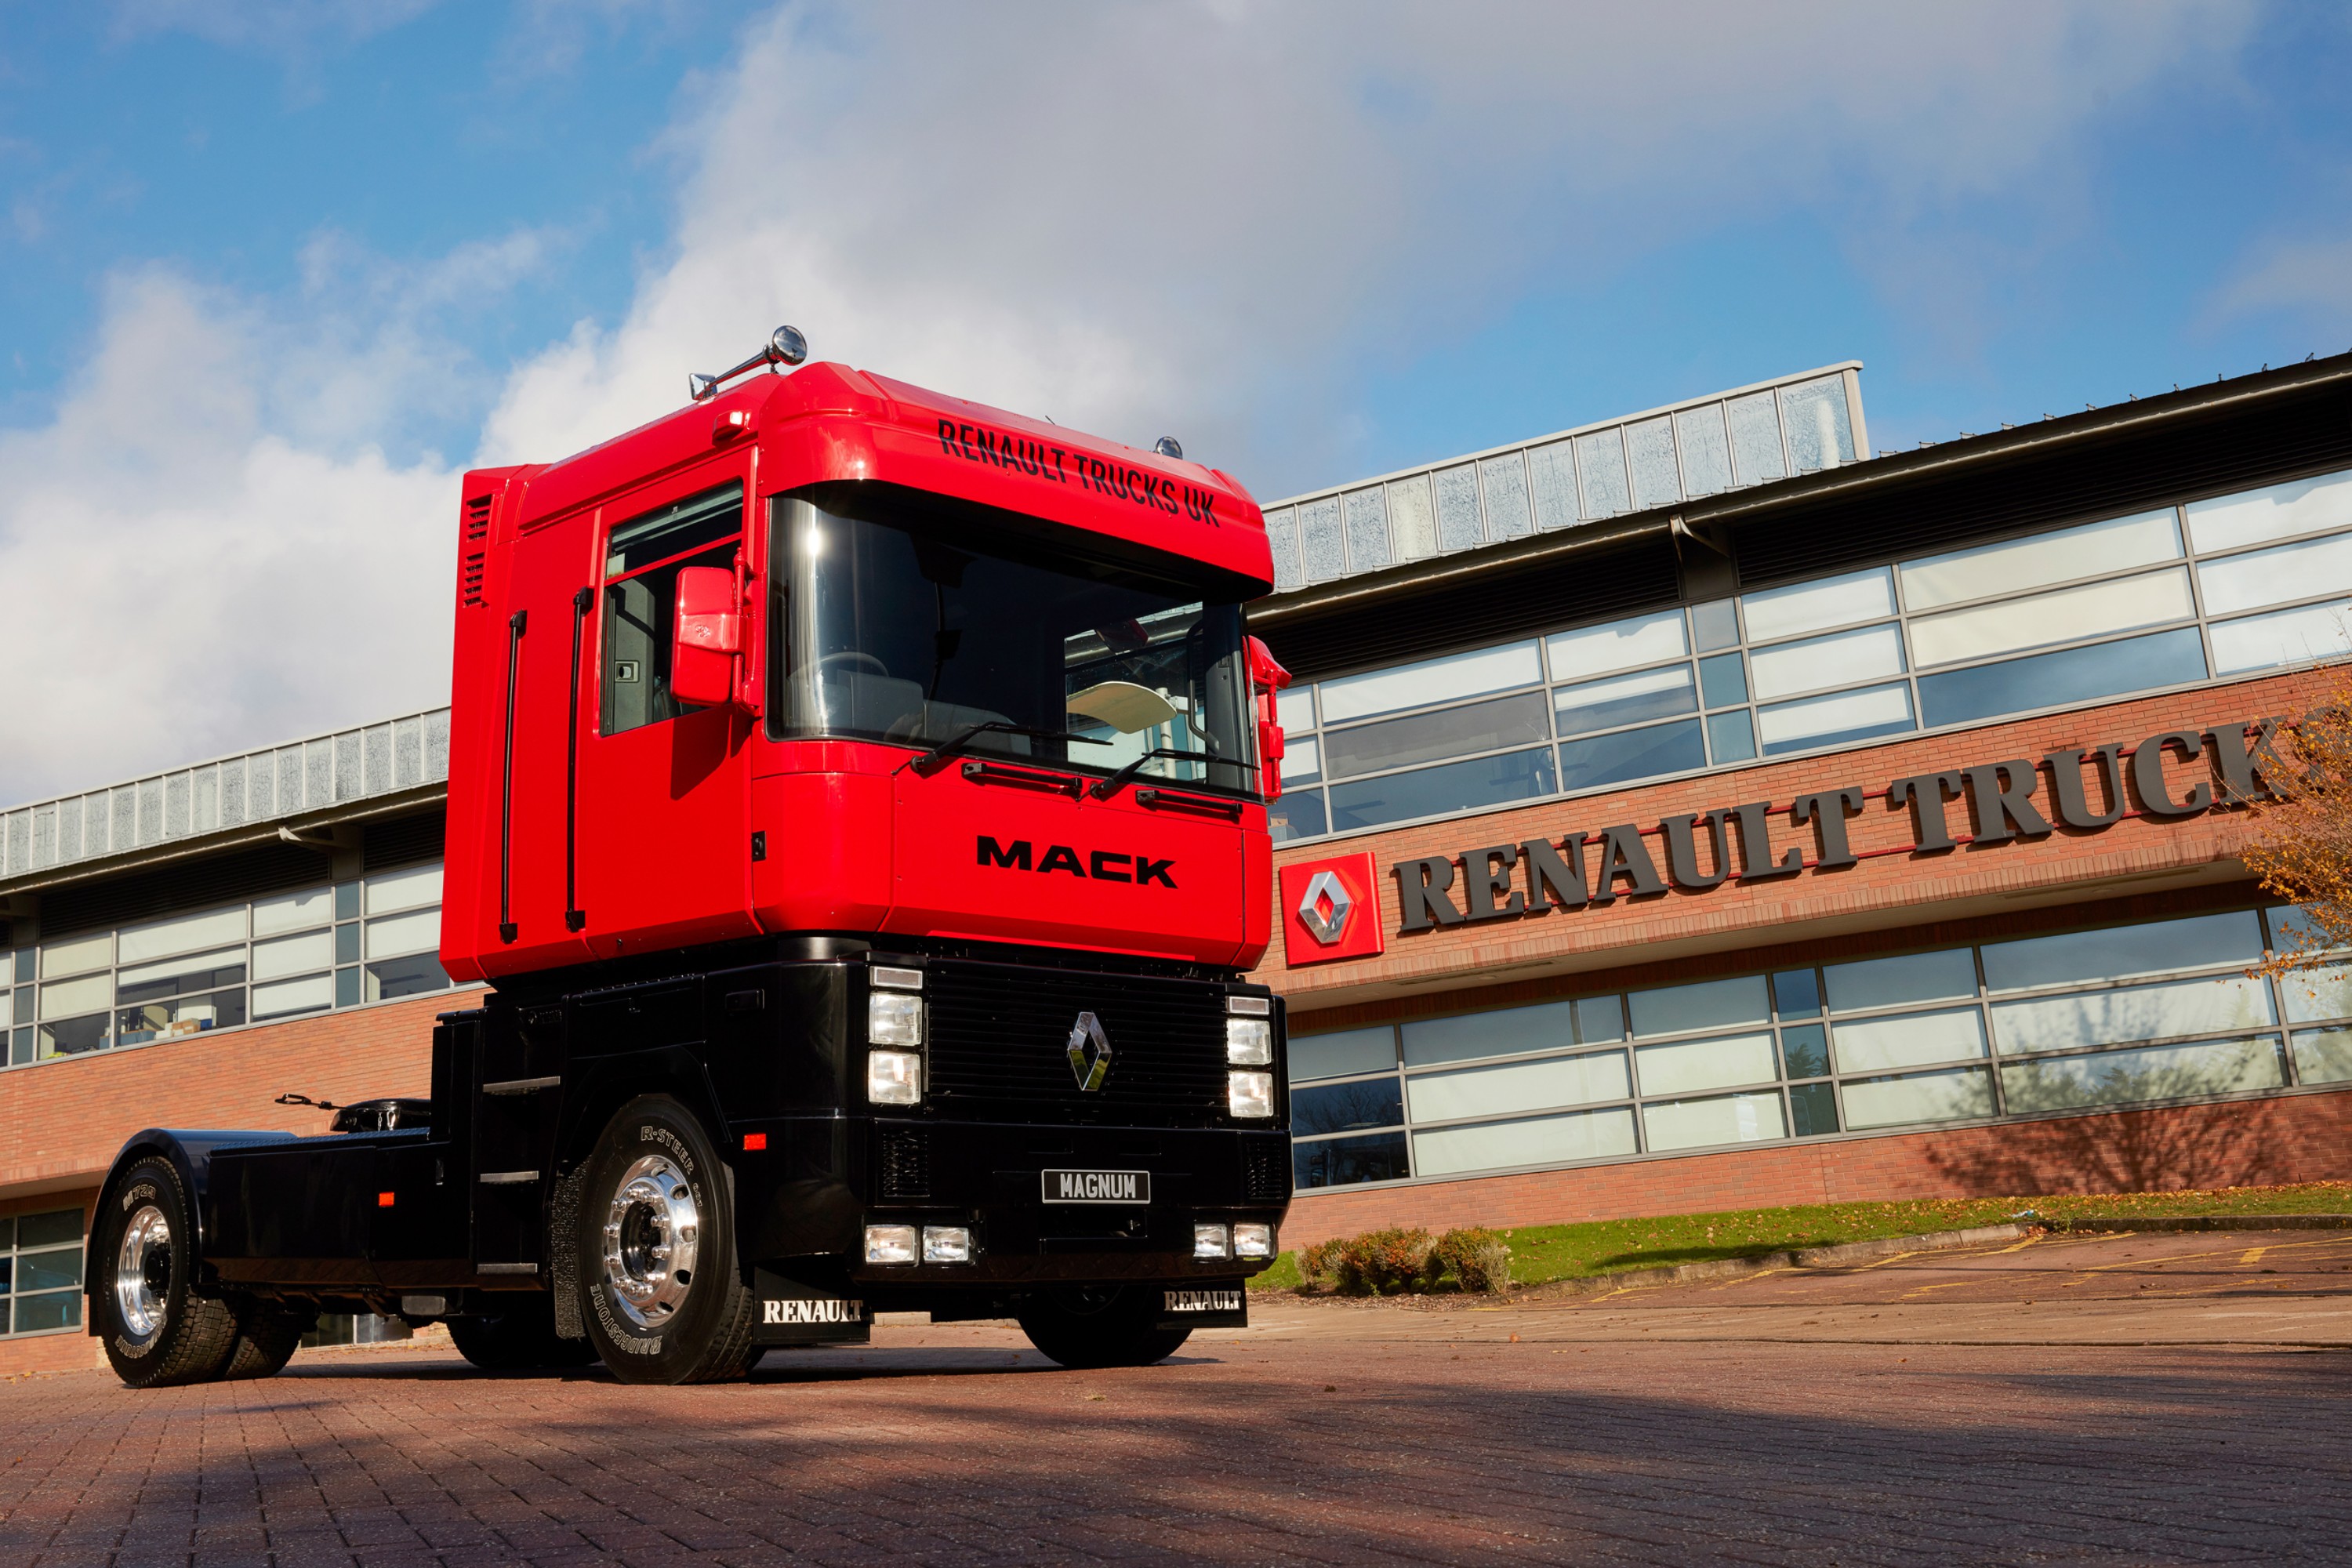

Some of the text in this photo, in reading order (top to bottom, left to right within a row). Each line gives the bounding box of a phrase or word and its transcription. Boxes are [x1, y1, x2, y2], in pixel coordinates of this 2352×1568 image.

[938, 419, 1221, 528] RENAULT TRUCKS UK
[977, 835, 1178, 889] MACK
[1392, 786, 1864, 932] RENAULT
[1060, 1173, 1136, 1199] MAGNUM
[590, 1283, 663, 1355] BRIDGESTONE
[762, 1300, 863, 1323] RENAULT
[1163, 1290, 1241, 1311] RENAULT
